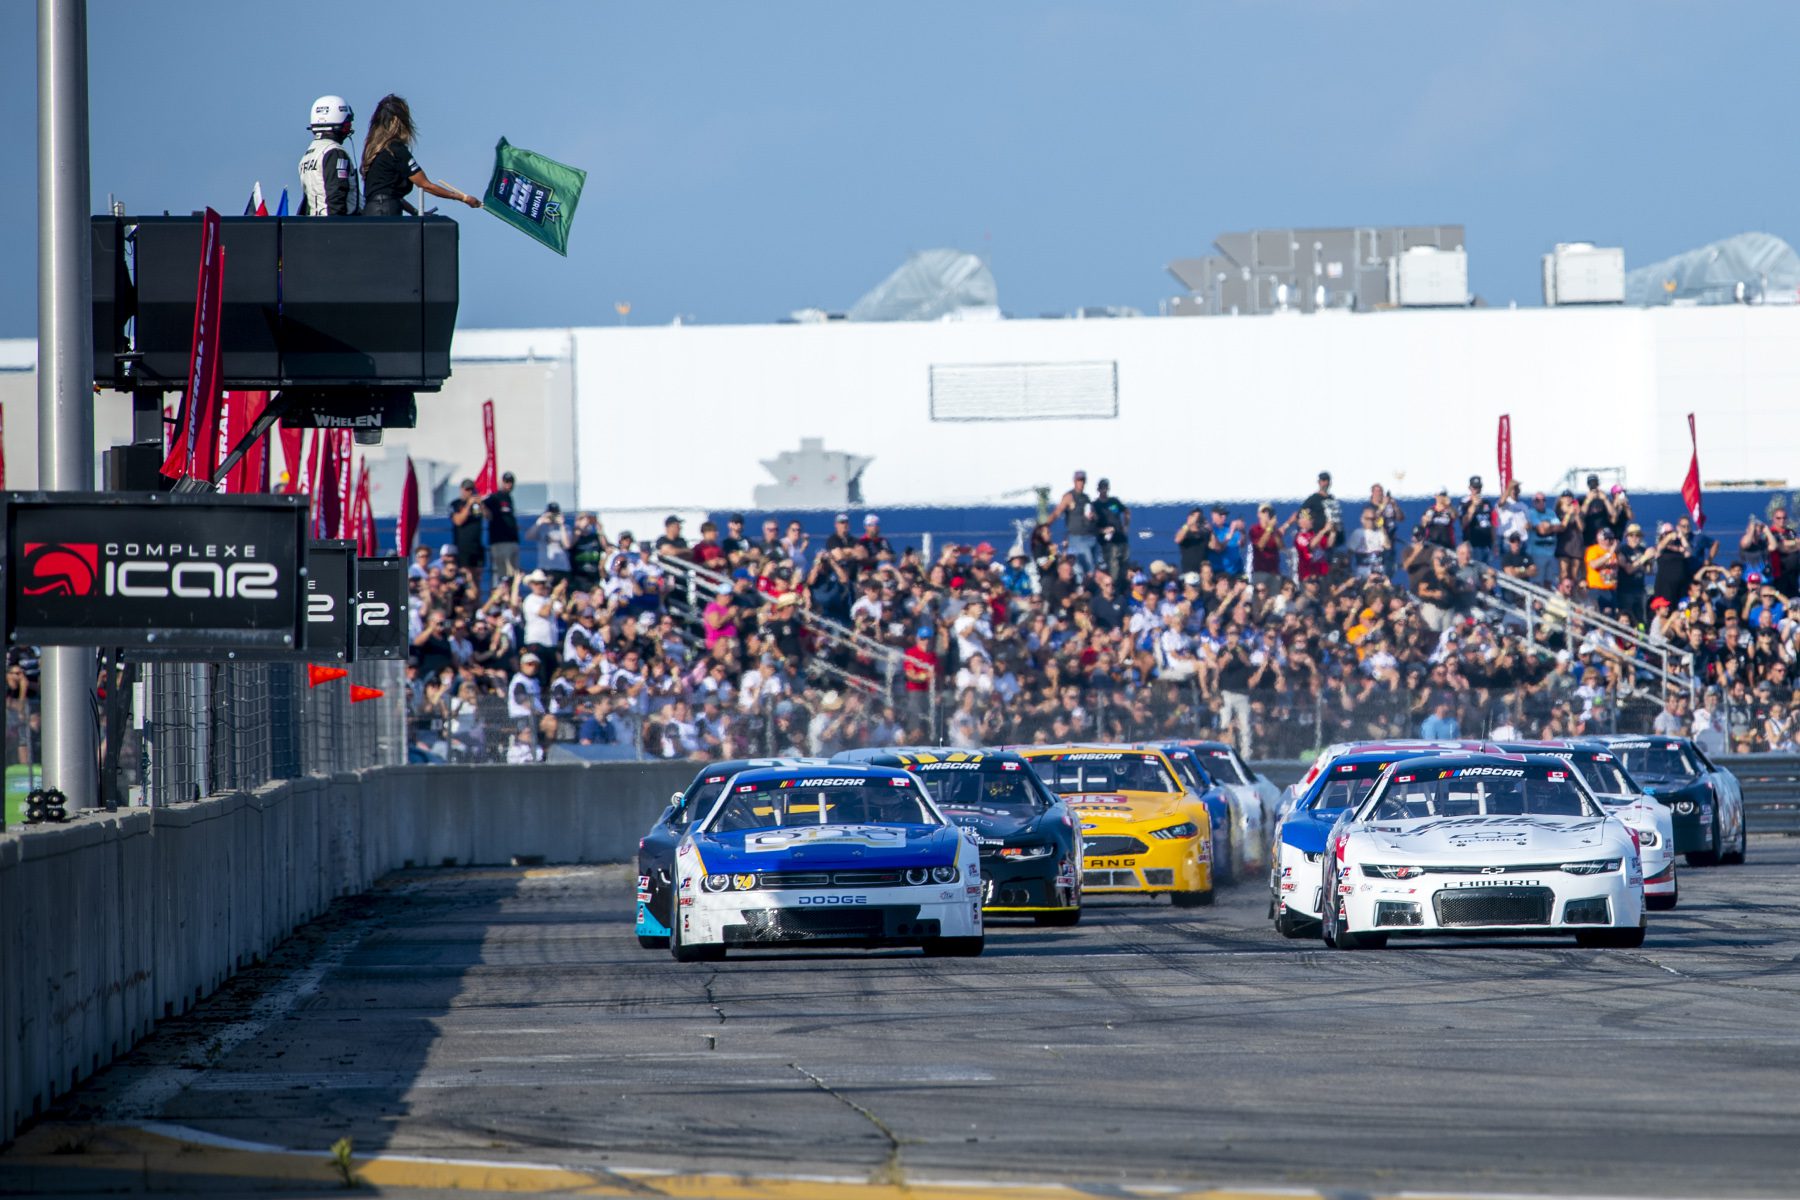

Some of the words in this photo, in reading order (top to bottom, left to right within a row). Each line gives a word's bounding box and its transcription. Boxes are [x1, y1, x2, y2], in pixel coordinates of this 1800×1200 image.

[313, 413, 382, 427] WHELEN
[105, 543, 256, 557] COMPLEXE
[105, 561, 278, 599] ICAR
[1459, 767, 1524, 777] NASCAR
[800, 778, 866, 787] NASCAR
[1444, 880, 1540, 888] CAMARO
[798, 896, 867, 905] DODGE
